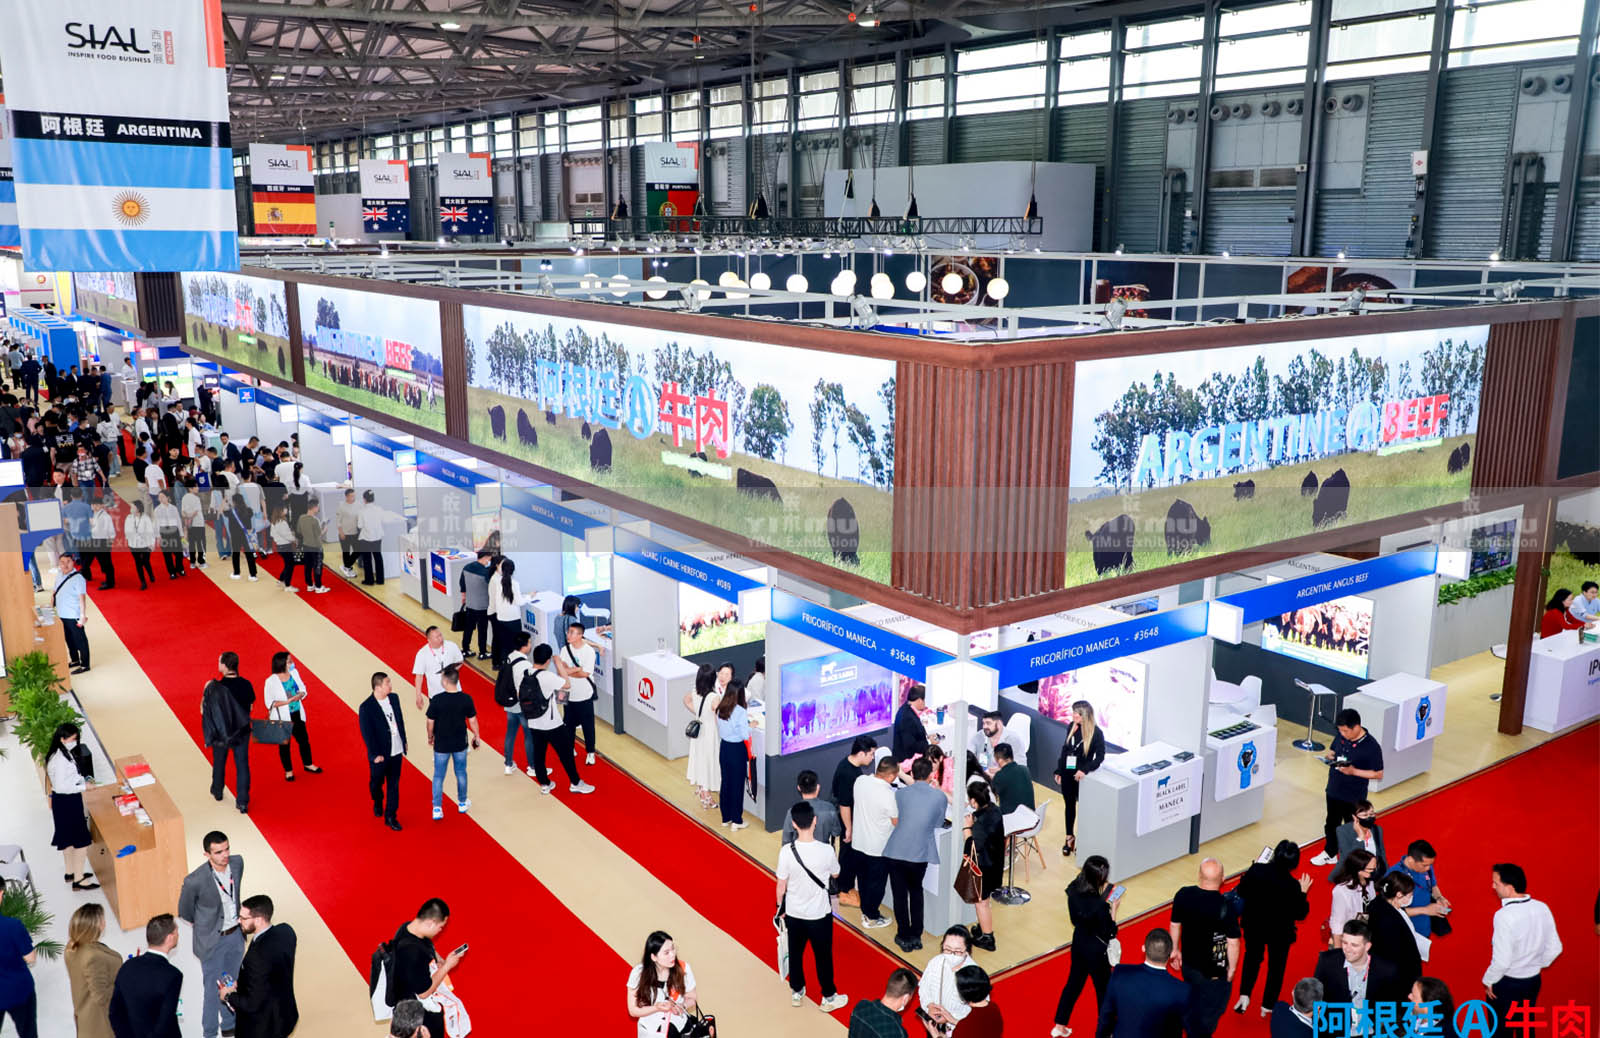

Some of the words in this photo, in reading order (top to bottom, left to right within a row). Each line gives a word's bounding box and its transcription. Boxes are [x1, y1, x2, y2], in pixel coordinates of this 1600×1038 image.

[65, 22, 151, 54] SIAL
[68, 51, 94, 59] INSPIRE
[119, 55, 151, 64] BUSINESS
[41, 116, 105, 137] 阿根廷
[117, 123, 202, 139] ARGENTINA
[268, 159, 291, 168] SIAL
[453, 169, 473, 177] SIAL
[537, 357, 621, 430] 阿根廷
[659, 380, 730, 460] 牛肉
[1137, 408, 1346, 482] ARGENTINE
[1382, 393, 1450, 443] BEEF
[663, 557, 679, 570] CARNE
[681, 564, 707, 582] HEREFORD
[717, 578, 732, 591] #089
[1296, 582, 1332, 599] ARGENTINE
[1333, 576, 1354, 589] ANGUS
[1355, 572, 1369, 583] BEEF
[802, 612, 844, 637] FRIGORÍFICO
[846, 630, 877, 650] MANECA
[890, 648, 916, 666] #3648
[1030, 645, 1084, 668] FRIGORÍFICO
[1085, 636, 1121, 654] MANECA
[1134, 626, 1159, 641] #3648
[1156, 788, 1171, 798] BLACK
[1172, 783, 1186, 793] LABEL
[1159, 797, 1184, 810] MANECA
